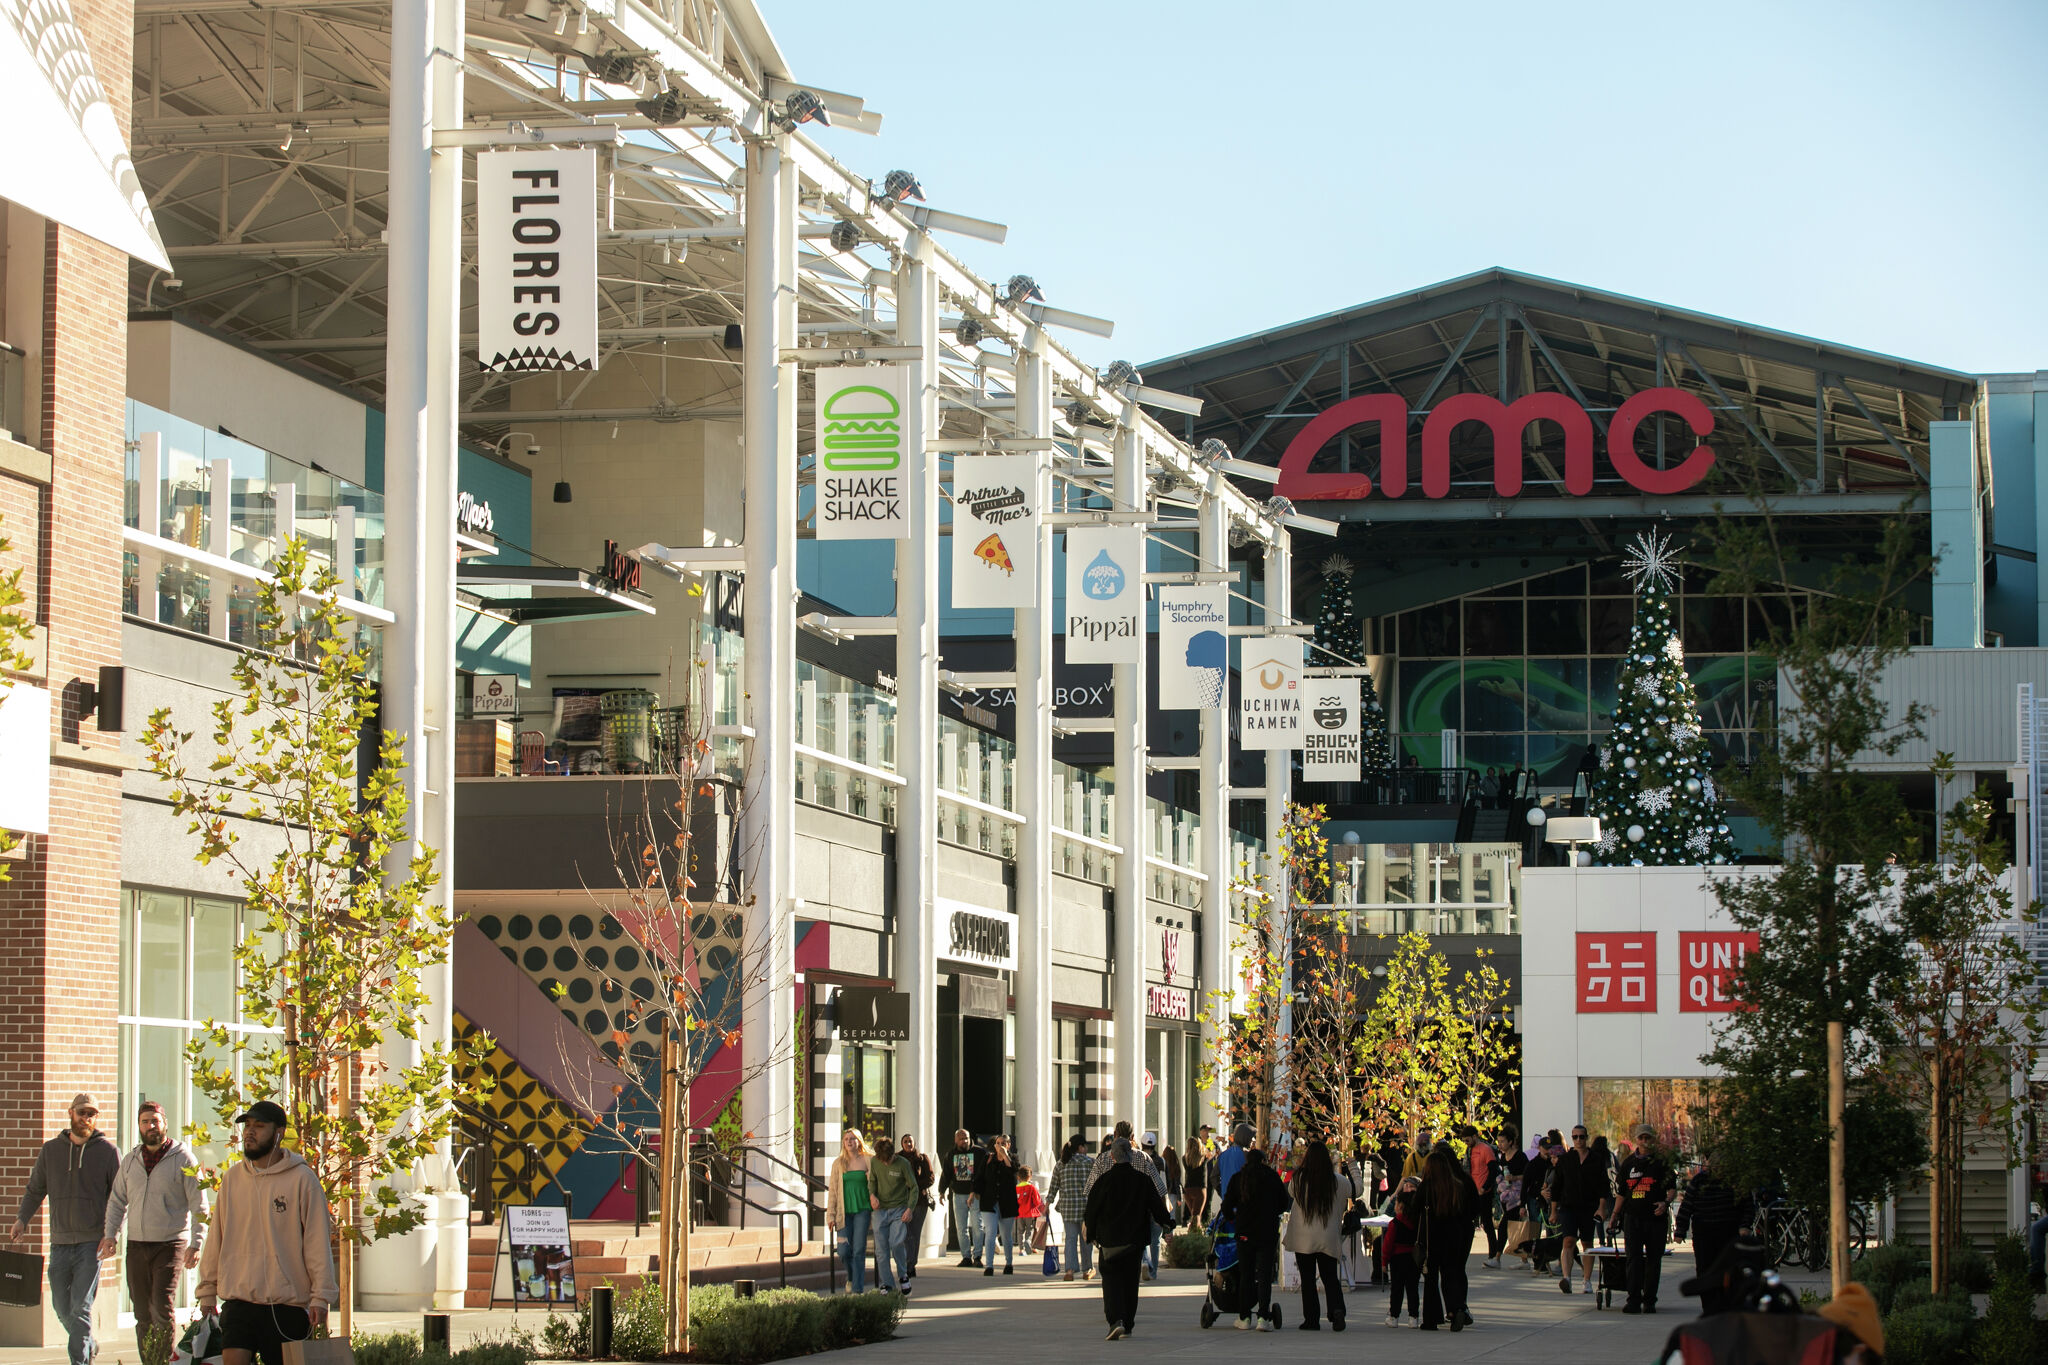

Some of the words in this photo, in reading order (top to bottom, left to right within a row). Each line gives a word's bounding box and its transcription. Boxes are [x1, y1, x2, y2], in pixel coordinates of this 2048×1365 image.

[512, 170, 561, 336] FLORES
[1273, 387, 1716, 499] amc
[824, 477, 898, 498] SHAKE
[957, 485, 1010, 505] Arthur
[824, 500, 901, 520] SHACK
[985, 505, 1032, 526] Mac's
[1162, 601, 1213, 614] Humphry
[1171, 612, 1225, 624] Slocombe
[1070, 616, 1137, 642] Pippāl
[1243, 699, 1301, 712] UCHIWA
[1247, 716, 1298, 729] RAMEN
[1305, 734, 1358, 748] SAUCY
[1305, 750, 1358, 764] ASIAN
[954, 911, 1011, 958] SEPHORA
[1689, 942, 1745, 969] UNI
[843, 1029, 905, 1038] SEPHORA
[521, 1209, 542, 1217] FLORES
